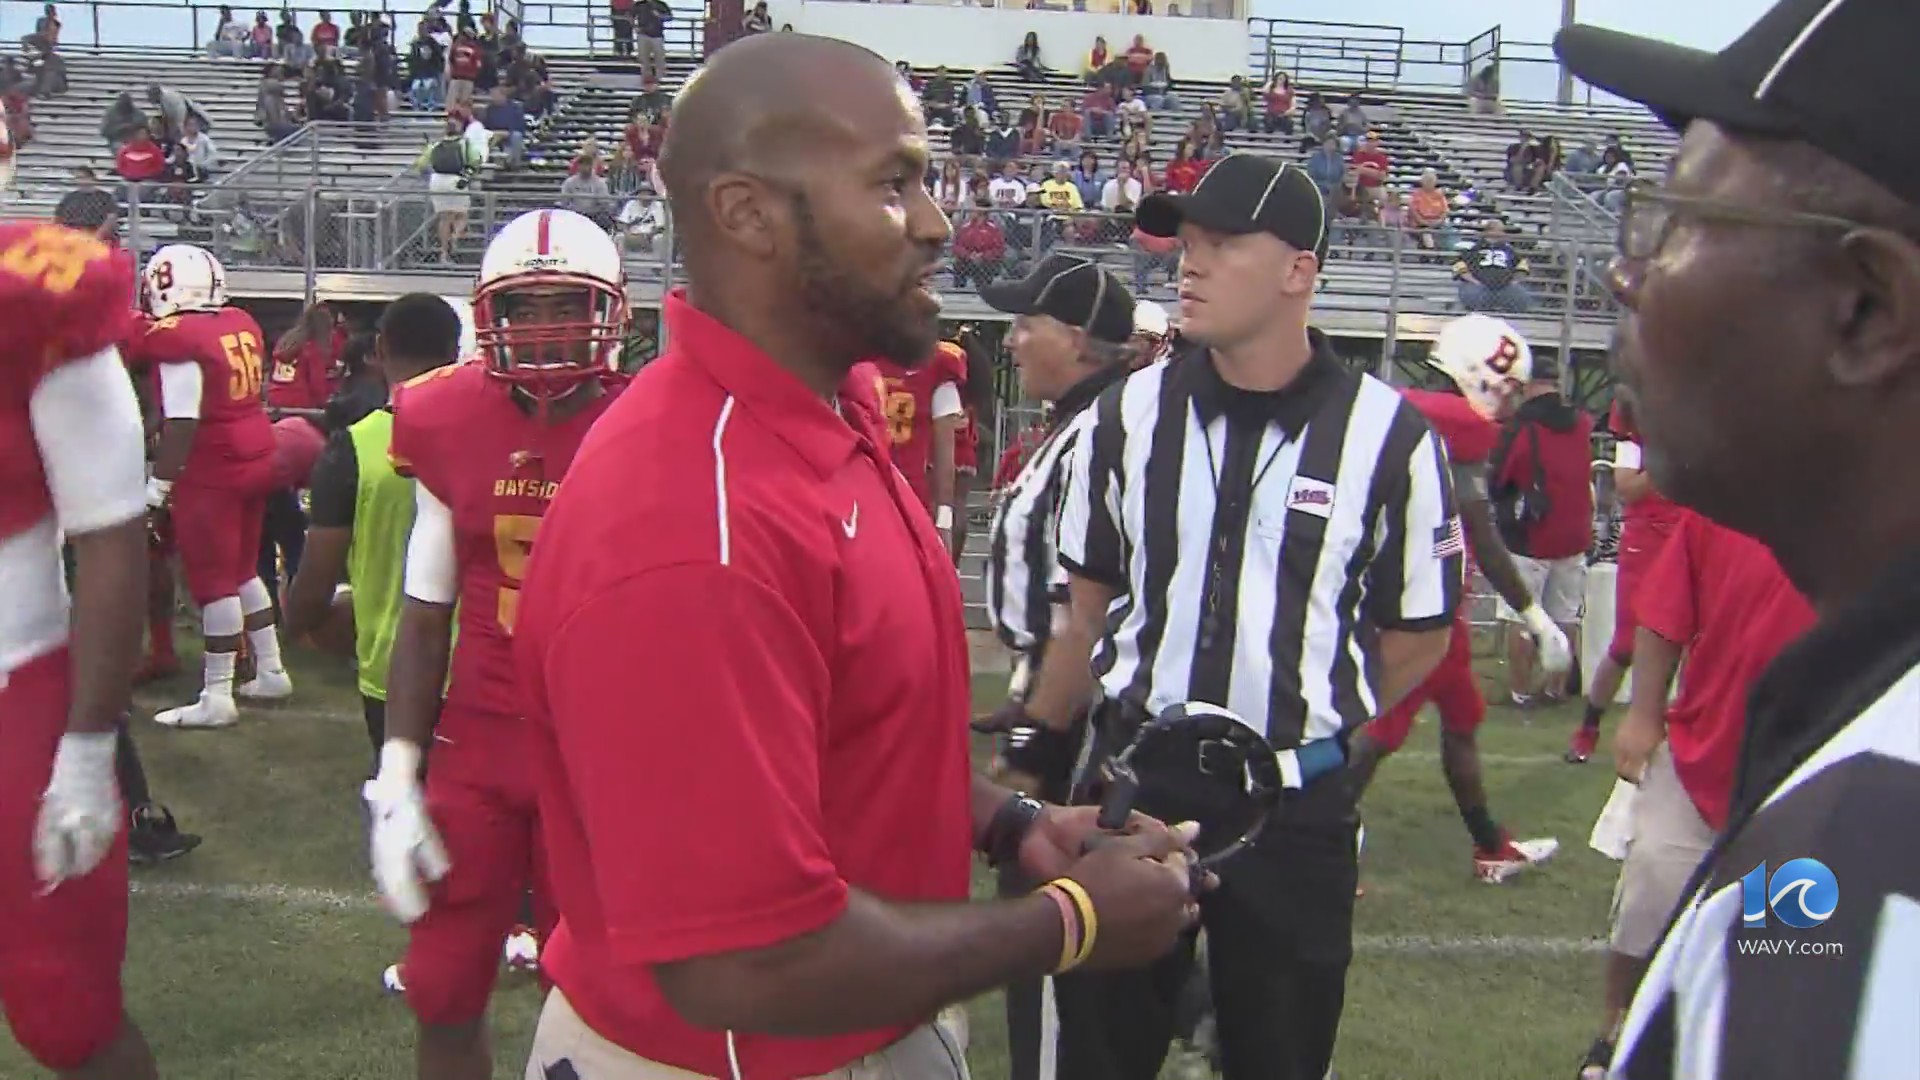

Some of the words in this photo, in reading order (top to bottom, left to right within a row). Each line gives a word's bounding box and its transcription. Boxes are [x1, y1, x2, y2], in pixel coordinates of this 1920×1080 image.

[1478, 249, 1508, 268] 32
[219, 330, 262, 400] 56
[1484, 335, 1519, 374] B
[493, 479, 561, 498] BAYSID
